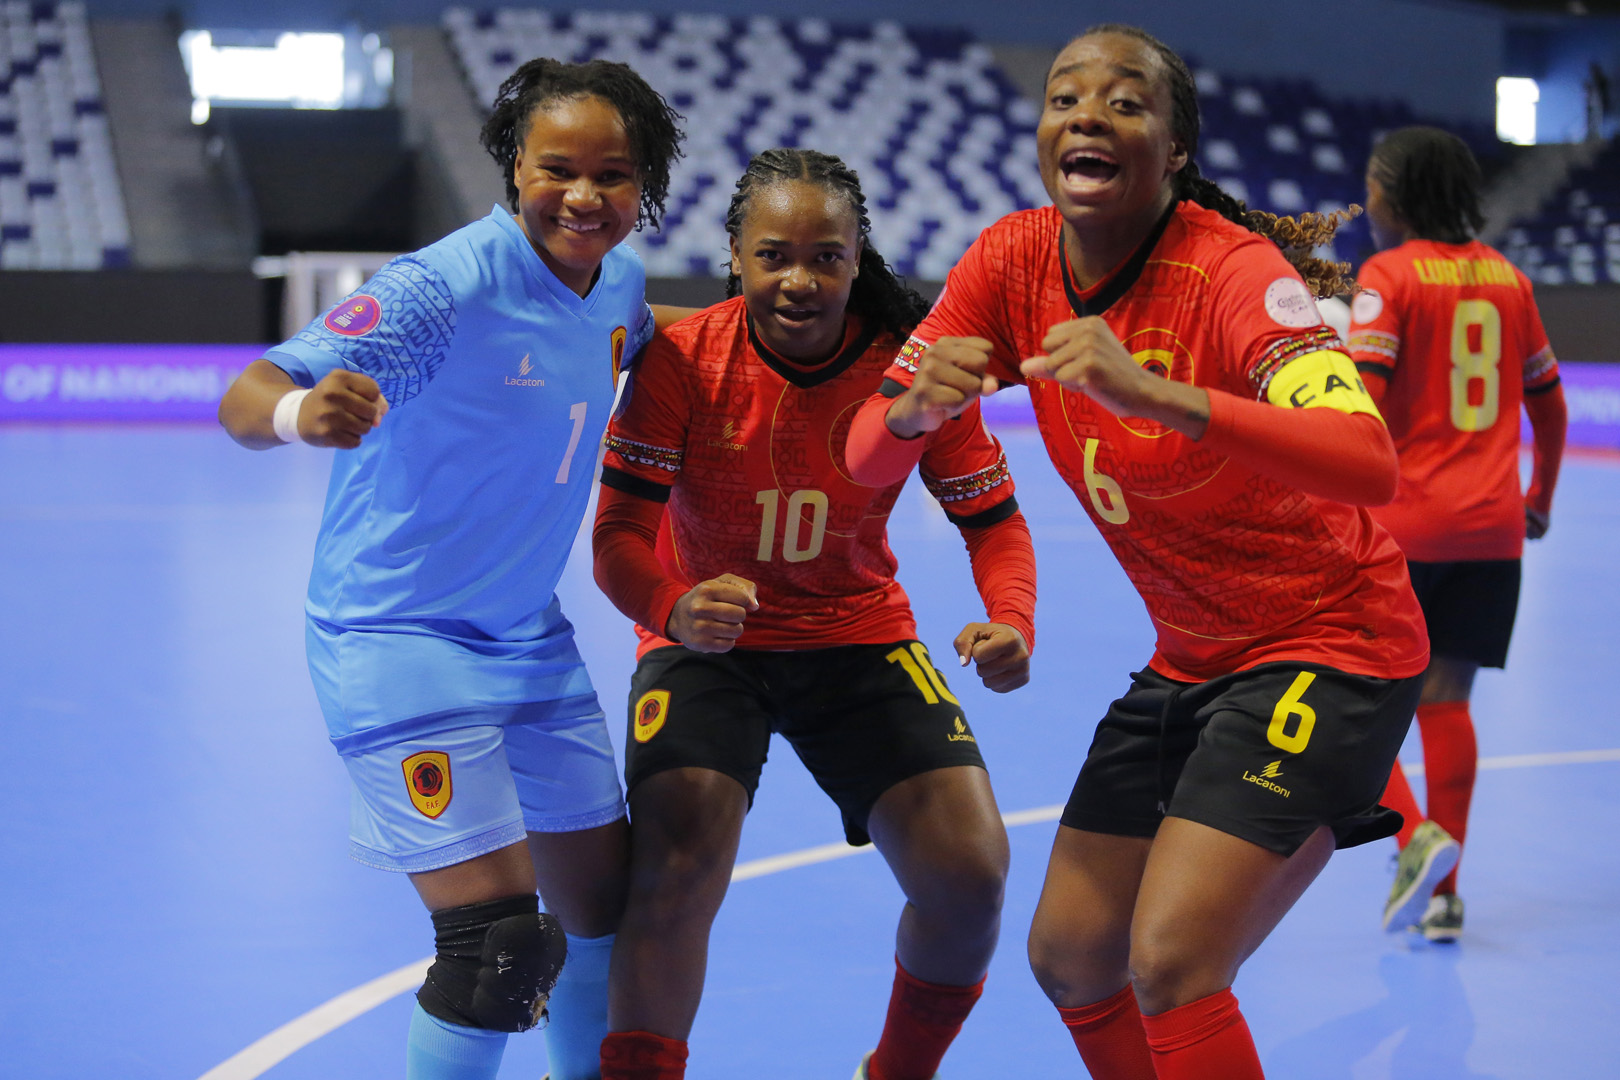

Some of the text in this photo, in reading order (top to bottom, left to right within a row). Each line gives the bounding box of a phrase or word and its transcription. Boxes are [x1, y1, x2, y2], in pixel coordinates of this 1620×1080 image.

[3, 364, 55, 401] OF
[504, 376, 545, 387] Lacatoni
[1289, 374, 1366, 408] CA
[1450, 299, 1501, 432] 8
[555, 402, 588, 484] 1
[707, 439, 748, 451] Lacatoni
[1084, 438, 1130, 525] 6
[756, 489, 829, 563] 10
[1267, 671, 1317, 754] 6
[1242, 770, 1291, 798] Lacatoni
